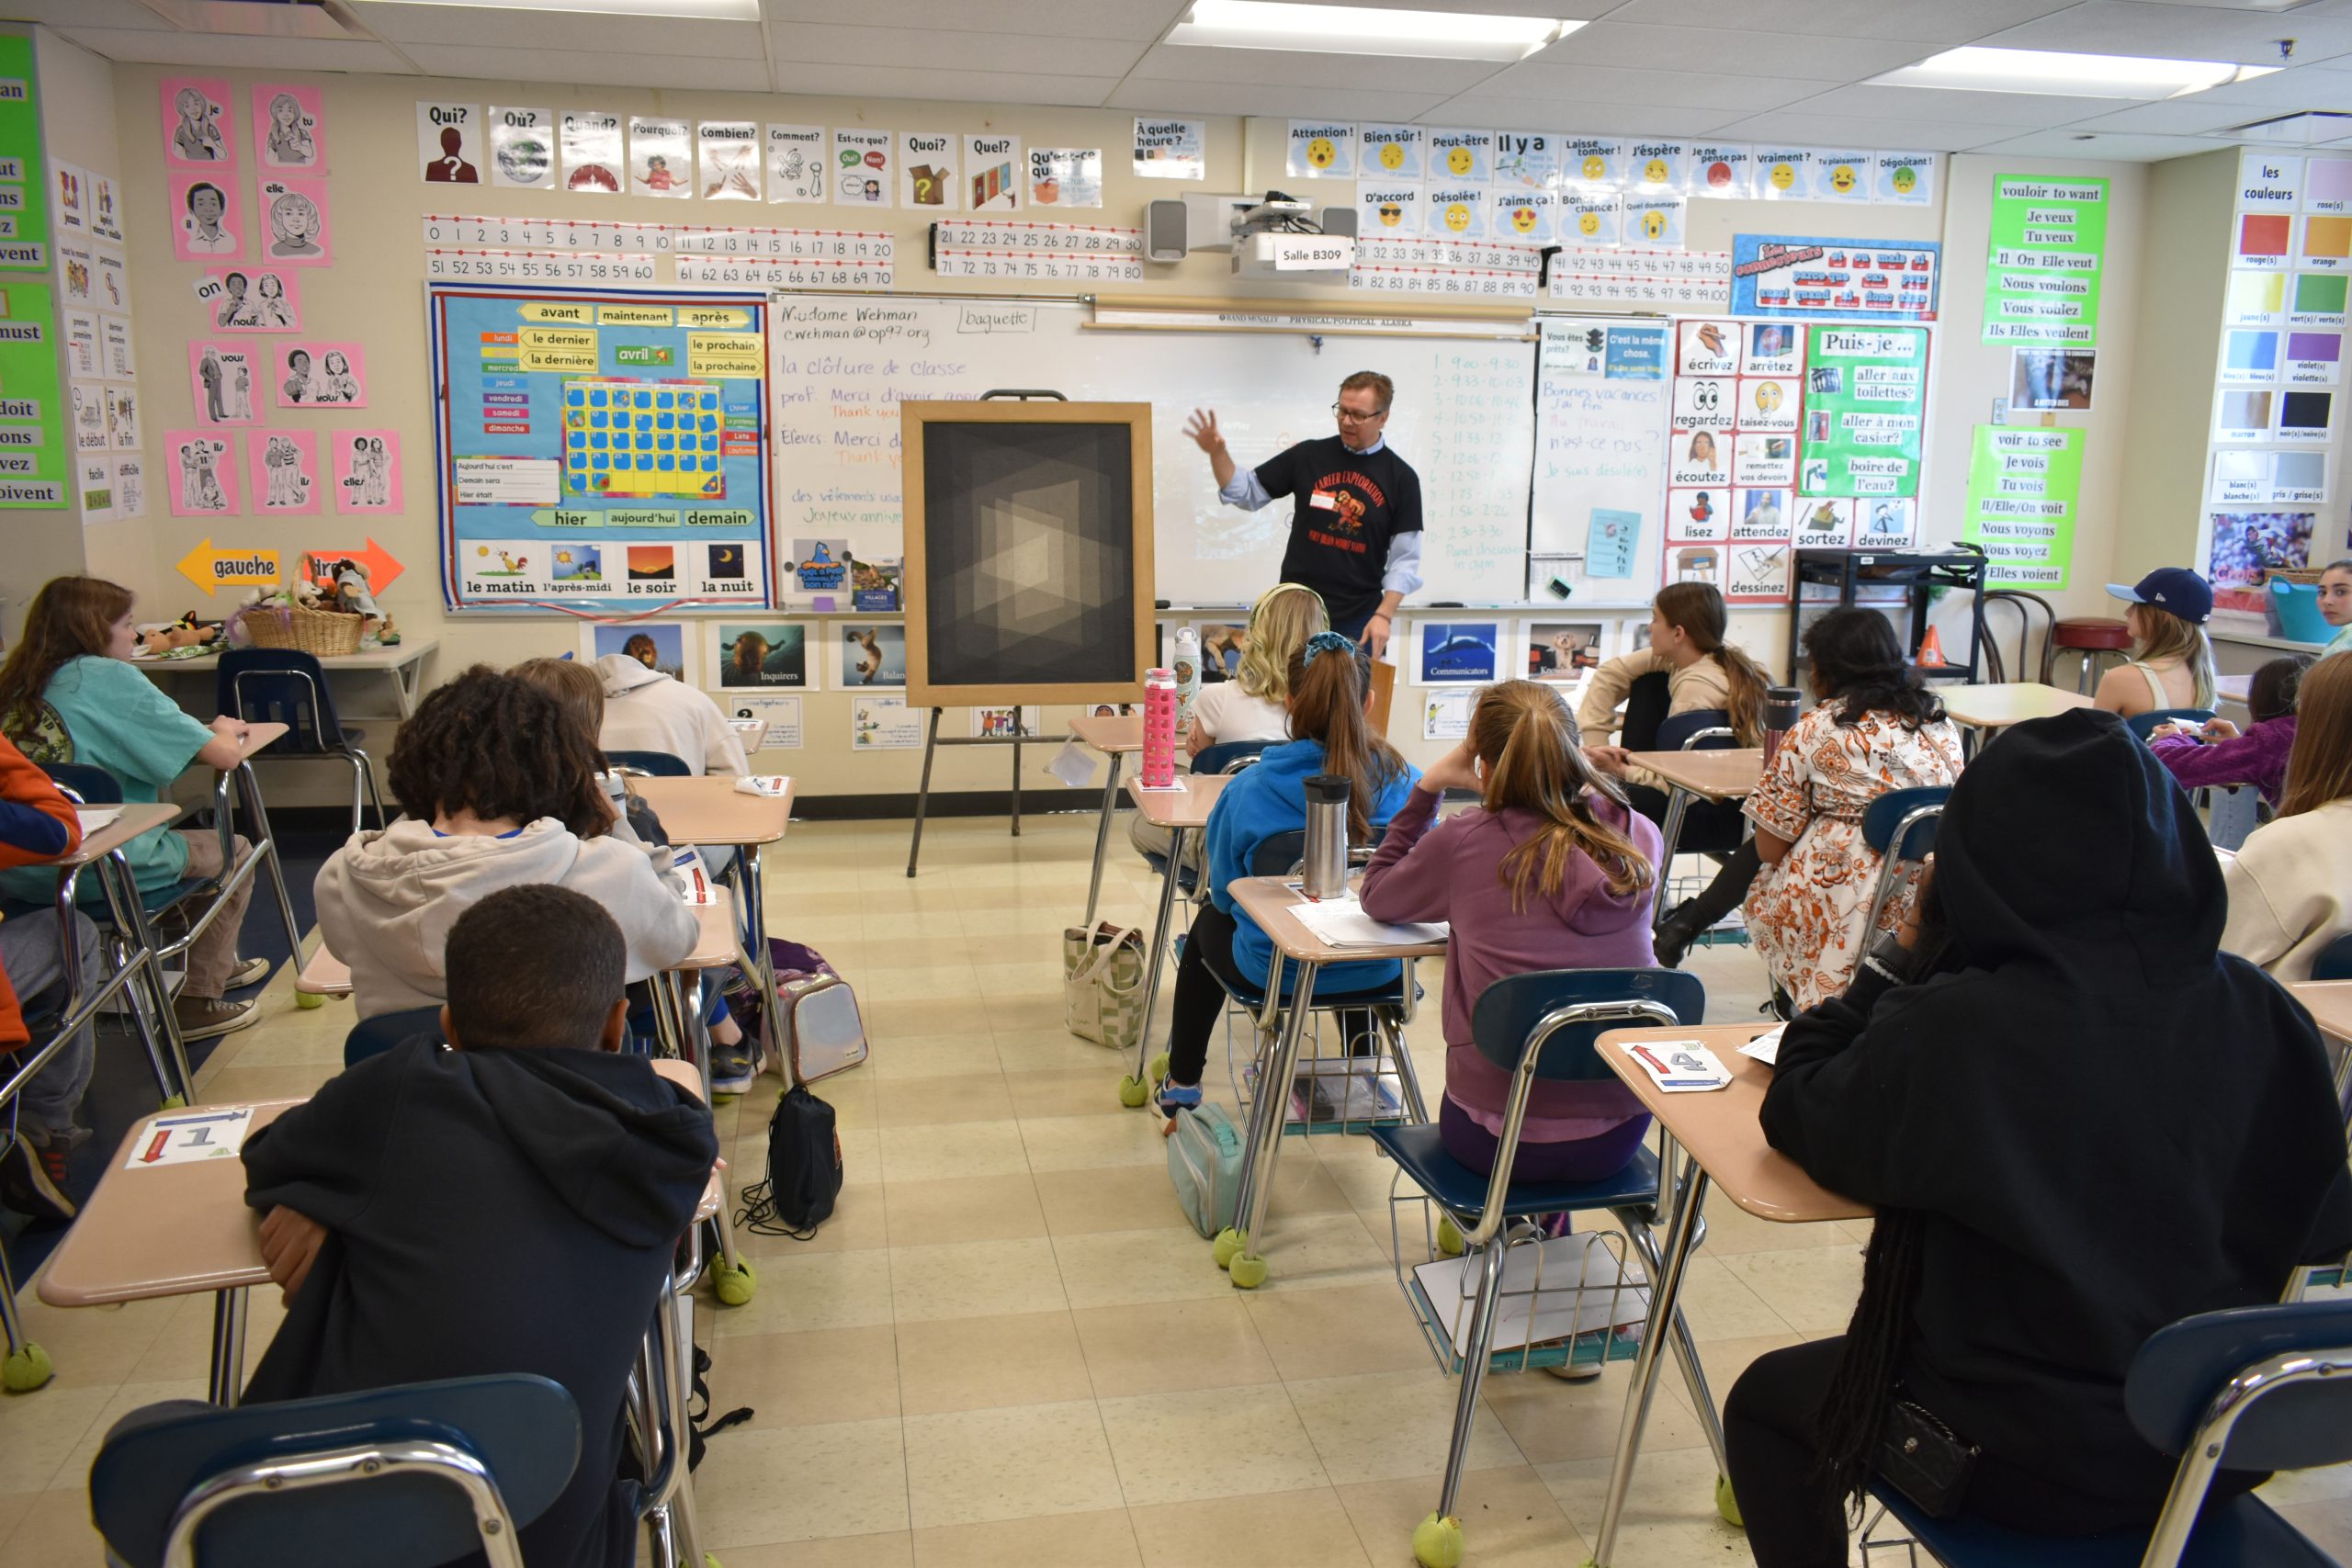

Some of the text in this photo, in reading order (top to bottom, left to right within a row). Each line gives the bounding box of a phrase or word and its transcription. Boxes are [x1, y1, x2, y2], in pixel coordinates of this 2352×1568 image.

[210, 105, 220, 116] je
[303, 118, 312, 127] tu
[430, 107, 467, 127] Qui?
[505, 112, 536, 128] Où?
[565, 117, 616, 131] Quand?
[633, 123, 687, 136] Pourquoi?
[1137, 122, 1185, 137] À quelle
[701, 127, 755, 139] Combien?
[772, 130, 820, 142] Comment?
[1293, 128, 1346, 138] Attention
[1364, 130, 1413, 142] Bien sûr
[837, 134, 888, 146] Est-ce que?
[909, 138, 946, 152] Quoi?
[1137, 135, 1182, 147] heure ?
[1433, 135, 1489, 147] Peut-être
[1566, 140, 1598, 149] Laisse
[974, 140, 1010, 154] Quel?
[1578, 147, 1613, 156] tomber
[1634, 144, 1680, 158] J'éspère
[866, 155, 884, 164] Non!
[1758, 152, 1811, 164] Vraiment ?
[1881, 157, 1926, 168] Dégoûtant
[2263, 165, 2278, 178] les
[266, 184, 284, 194] elle
[2003, 186, 2098, 200] vouloir to want
[2245, 187, 2292, 200] couleurs
[1365, 191, 1414, 203] D'accord
[1433, 191, 1475, 202] Désolée
[1498, 197, 1548, 208] J'aime ça
[1576, 203, 1611, 213] chance
[2317, 200, 2343, 211] rose(s)
[430, 228, 669, 249] 0 1 2 3 4 5 6 7 8 9 10
[1283, 250, 1340, 261] Salle B309
[1999, 253, 2092, 268] Il On Elle veut
[2246, 255, 2277, 265] rouge(s)
[2312, 257, 2335, 266] orange
[198, 281, 221, 298] on
[2003, 278, 2086, 293] Nous voulons
[541, 308, 579, 319] avant
[603, 311, 667, 321] maintenant
[692, 312, 729, 324] après
[781, 307, 918, 323] Madame Wehman
[233, 318, 256, 326] nous
[966, 310, 1027, 333] baguette
[1381, 318, 1412, 327] ALASKA
[1547, 333, 1583, 342] Vous êtes
[1989, 325, 2089, 340] Ils Elles veulent
[534, 334, 590, 344] le dernier
[1610, 335, 1630, 344] C'est
[1633, 335, 1640, 344] la
[619, 348, 649, 360] avril
[1623, 349, 1650, 357] chose.
[531, 354, 594, 366] la dernière
[782, 355, 966, 376] la clôture de classe
[1690, 358, 1732, 370] écrivez
[1750, 359, 1792, 371] arrêtez
[1857, 369, 1915, 381] aller aux
[2292, 373, 2327, 384] violette(s)
[496, 379, 514, 388] jeudi
[1544, 382, 1592, 399] Bonnes
[1857, 386, 1915, 399] toilettes?
[489, 394, 522, 402] vendredi
[1676, 413, 1732, 428] regardez
[1740, 418, 1794, 428] taisez-vous
[489, 424, 525, 433] dimanche
[79, 434, 106, 447] le début
[119, 433, 133, 446] la fin
[1998, 434, 2062, 446] voir to see
[213, 443, 223, 452] ils
[458, 463, 494, 472] Aujourd'hui
[1747, 462, 1783, 470] remettez
[1850, 461, 1902, 473] boire de
[89, 468, 104, 480] facile
[1757, 472, 1787, 481] devoirs
[344, 478, 365, 487] elles
[1315, 470, 1385, 507] CAREER EXPLORATION
[1858, 478, 1894, 491] l'eau?
[2224, 491, 2259, 501] blanche(s)
[555, 512, 586, 525] hier
[612, 513, 675, 524] aujourd'hui
[689, 512, 747, 524] demain
[803, 508, 856, 524] Joyeux
[1734, 525, 1788, 537] attendez
[1982, 523, 2055, 537] Nous voyons
[1798, 533, 1844, 545] sortez
[1860, 533, 1908, 546] devinez
[214, 556, 275, 577] gauche
[2215, 564, 2259, 582] Crois
[467, 581, 536, 592] le matin
[543, 582, 611, 593] l'après-midi
[702, 581, 752, 592] la nuit
[1732, 581, 1784, 593] dessinez
[761, 671, 798, 681] Inquirers
[1430, 666, 1488, 676] Communicators
[178, 1127, 216, 1146] 1
